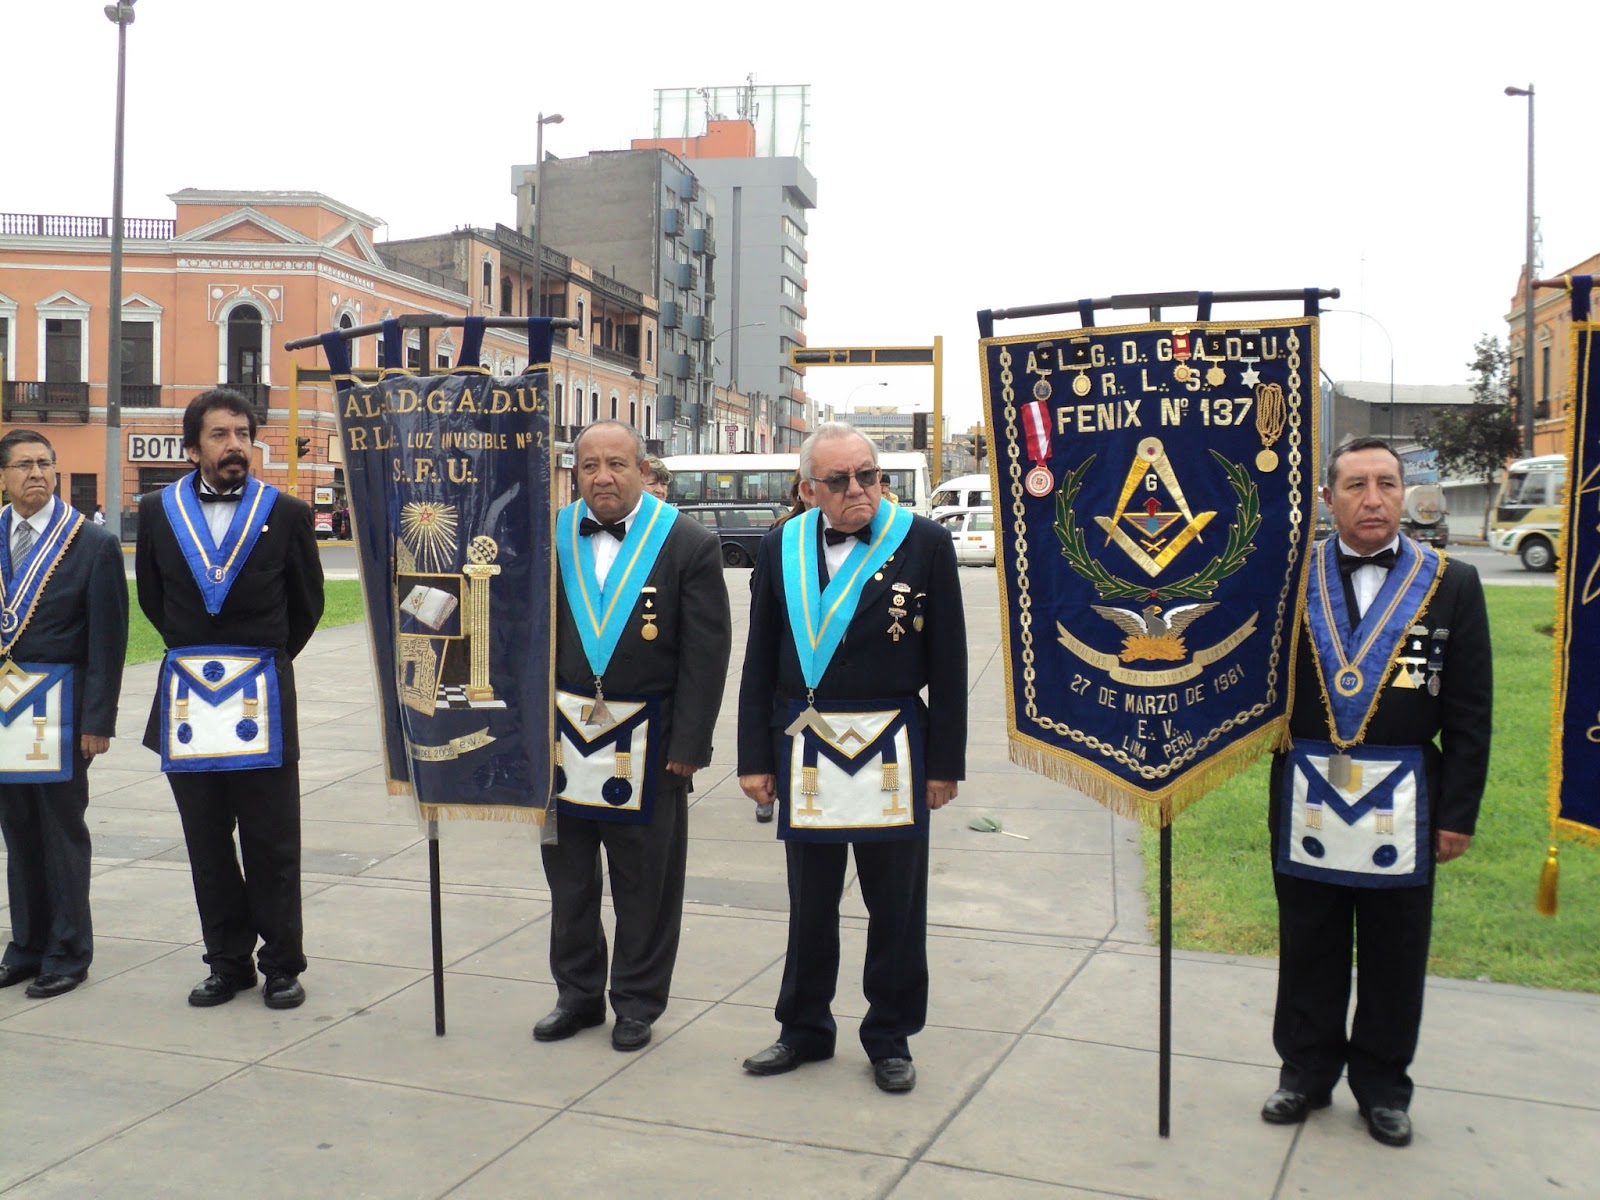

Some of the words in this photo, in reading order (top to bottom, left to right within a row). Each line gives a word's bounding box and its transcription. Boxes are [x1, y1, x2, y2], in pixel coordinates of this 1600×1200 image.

[1057, 400, 1142, 434] FENIX
[1200, 398, 1253, 426] 137
[407, 432, 433, 449] LUZ
[441, 431, 507, 449] INVISIBLE
[1145, 473, 1158, 492] G
[215, 569, 222, 580] 8
[2, 613, 10, 627] 3
[1070, 673, 1092, 696] 27
[1098, 686, 1118, 709] DE
[1125, 693, 1178, 715] MARZO
[1185, 683, 1205, 706] DE
[1213, 663, 1245, 694] 1981
[1341, 676, 1357, 687] 137
[1122, 735, 1147, 760] LIMA
